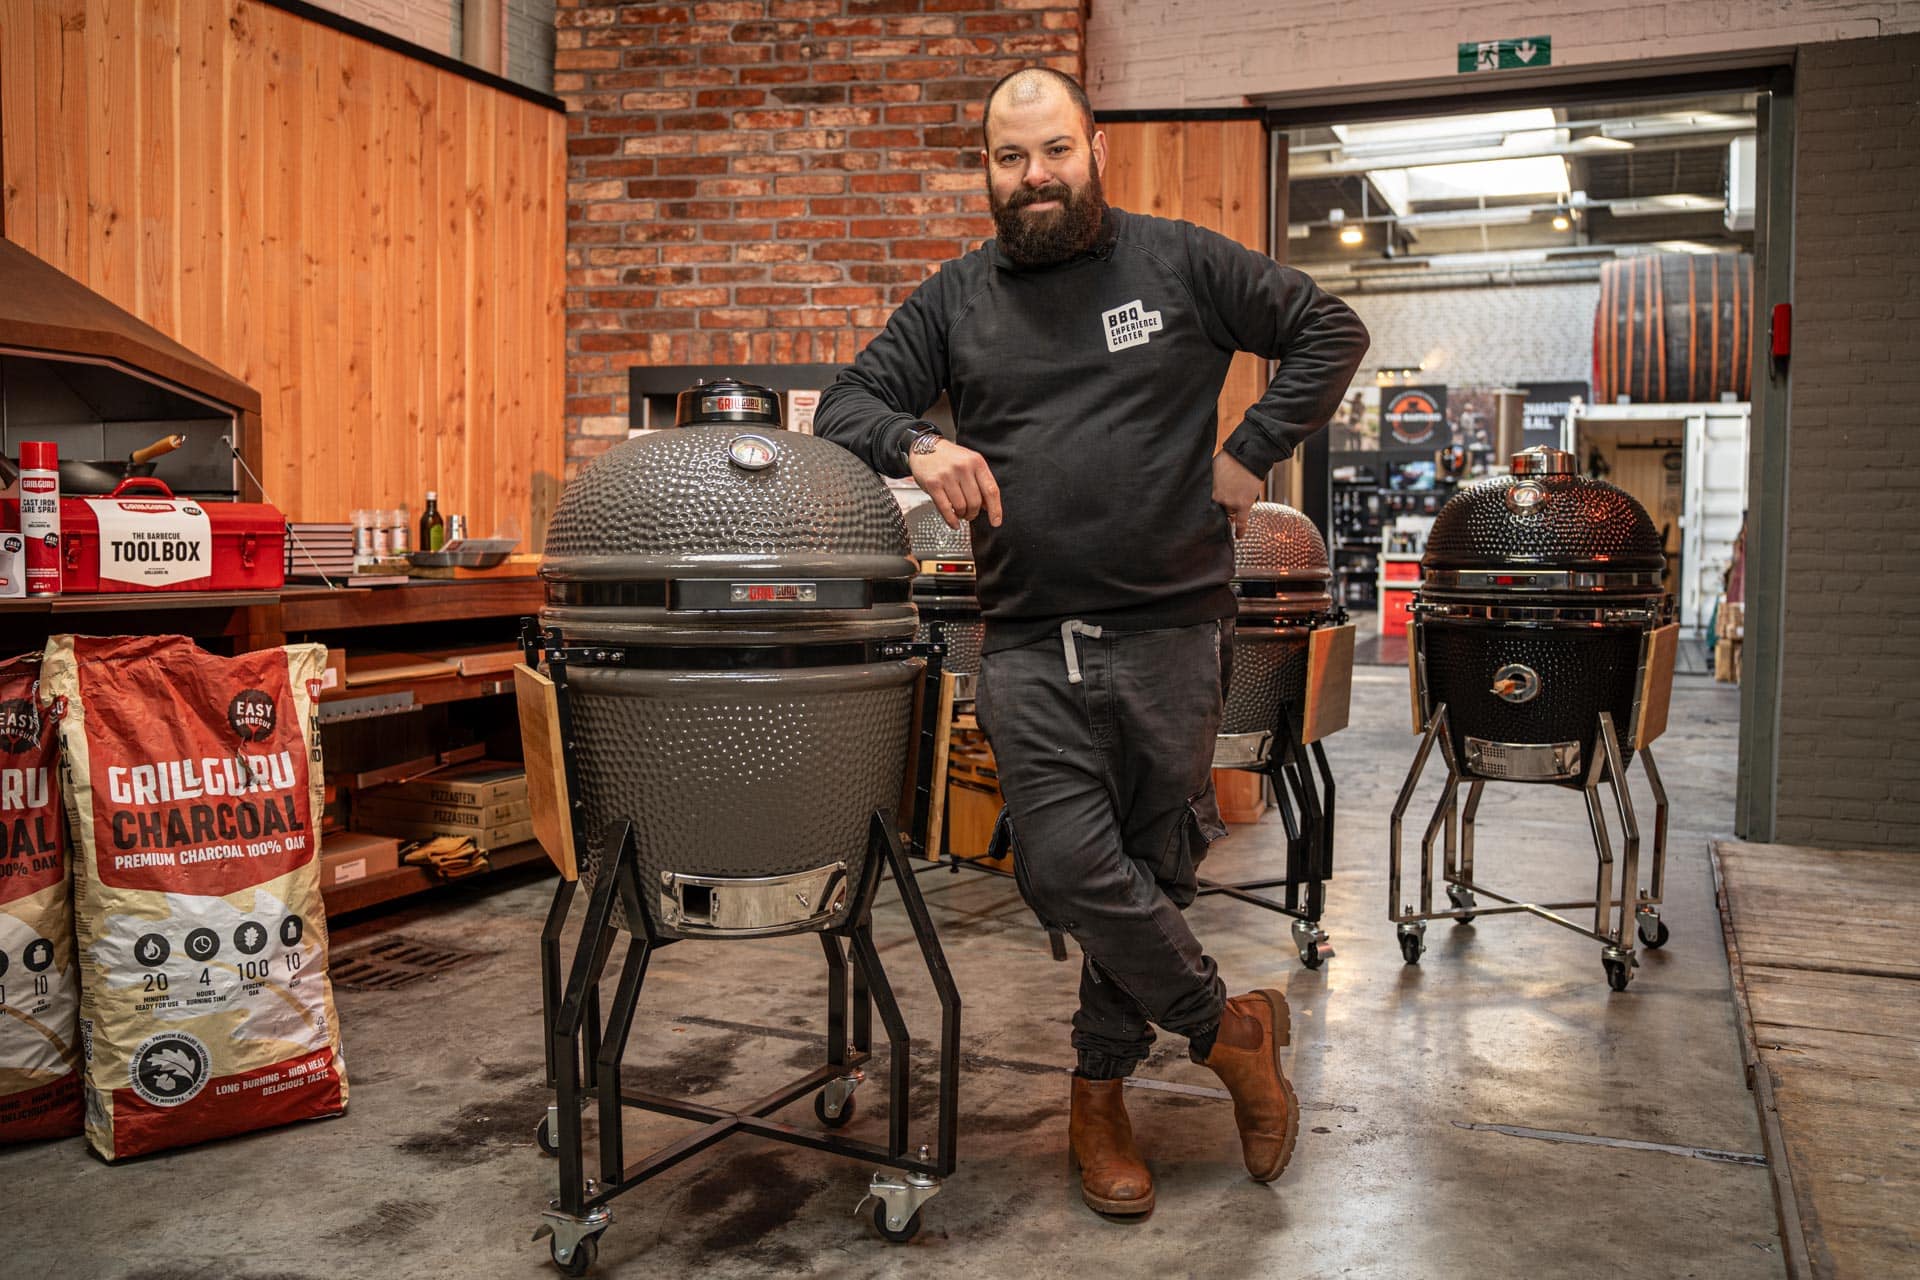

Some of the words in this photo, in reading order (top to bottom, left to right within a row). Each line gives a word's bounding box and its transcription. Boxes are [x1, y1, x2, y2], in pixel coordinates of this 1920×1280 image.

[1108, 307, 1138, 328] BBQ
[1111, 318, 1157, 336] EXPERIENCE
[1113, 330, 1143, 345] CENTER
[132, 532, 145, 540] THE
[147, 532, 180, 540] BARBECUE
[111, 541, 200, 562] TOOLBOX
[237, 701, 272, 718] EASY
[236, 717, 271, 729] BARBECUE
[0, 728, 34, 743] ARBECUE
[108, 751, 297, 805] GRILLGURU
[112, 795, 304, 849] CHARCOAL
[115, 853, 175, 870] PREMIUM
[180, 845, 244, 865] CHARCOAL
[246, 840, 282, 857] 100%
[285, 836, 306, 851] OAK
[33, 855, 58, 872] OAK
[237, 959, 269, 981] 100
[285, 952, 300, 971] 10
[35, 975, 47, 996] 10
[143, 973, 168, 992] 20
[199, 968, 211, 986] 4
[242, 982, 266, 991] PERCENT
[135, 1003, 154, 1011] READY
[155, 1001, 167, 1009] FOR
[168, 1000, 179, 1008] USE
[144, 995, 169, 1003] MINUTES
[186, 997, 212, 1006] BURNING
[213, 995, 227, 1003] TIME
[216, 1083, 240, 1096] LONG
[242, 1073, 280, 1090] BURNING
[288, 1066, 307, 1078] HIGH
[309, 1057, 326, 1071] HEAT
[262, 1078, 304, 1096] DELICIOUS
[308, 1069, 329, 1083] TASTE
